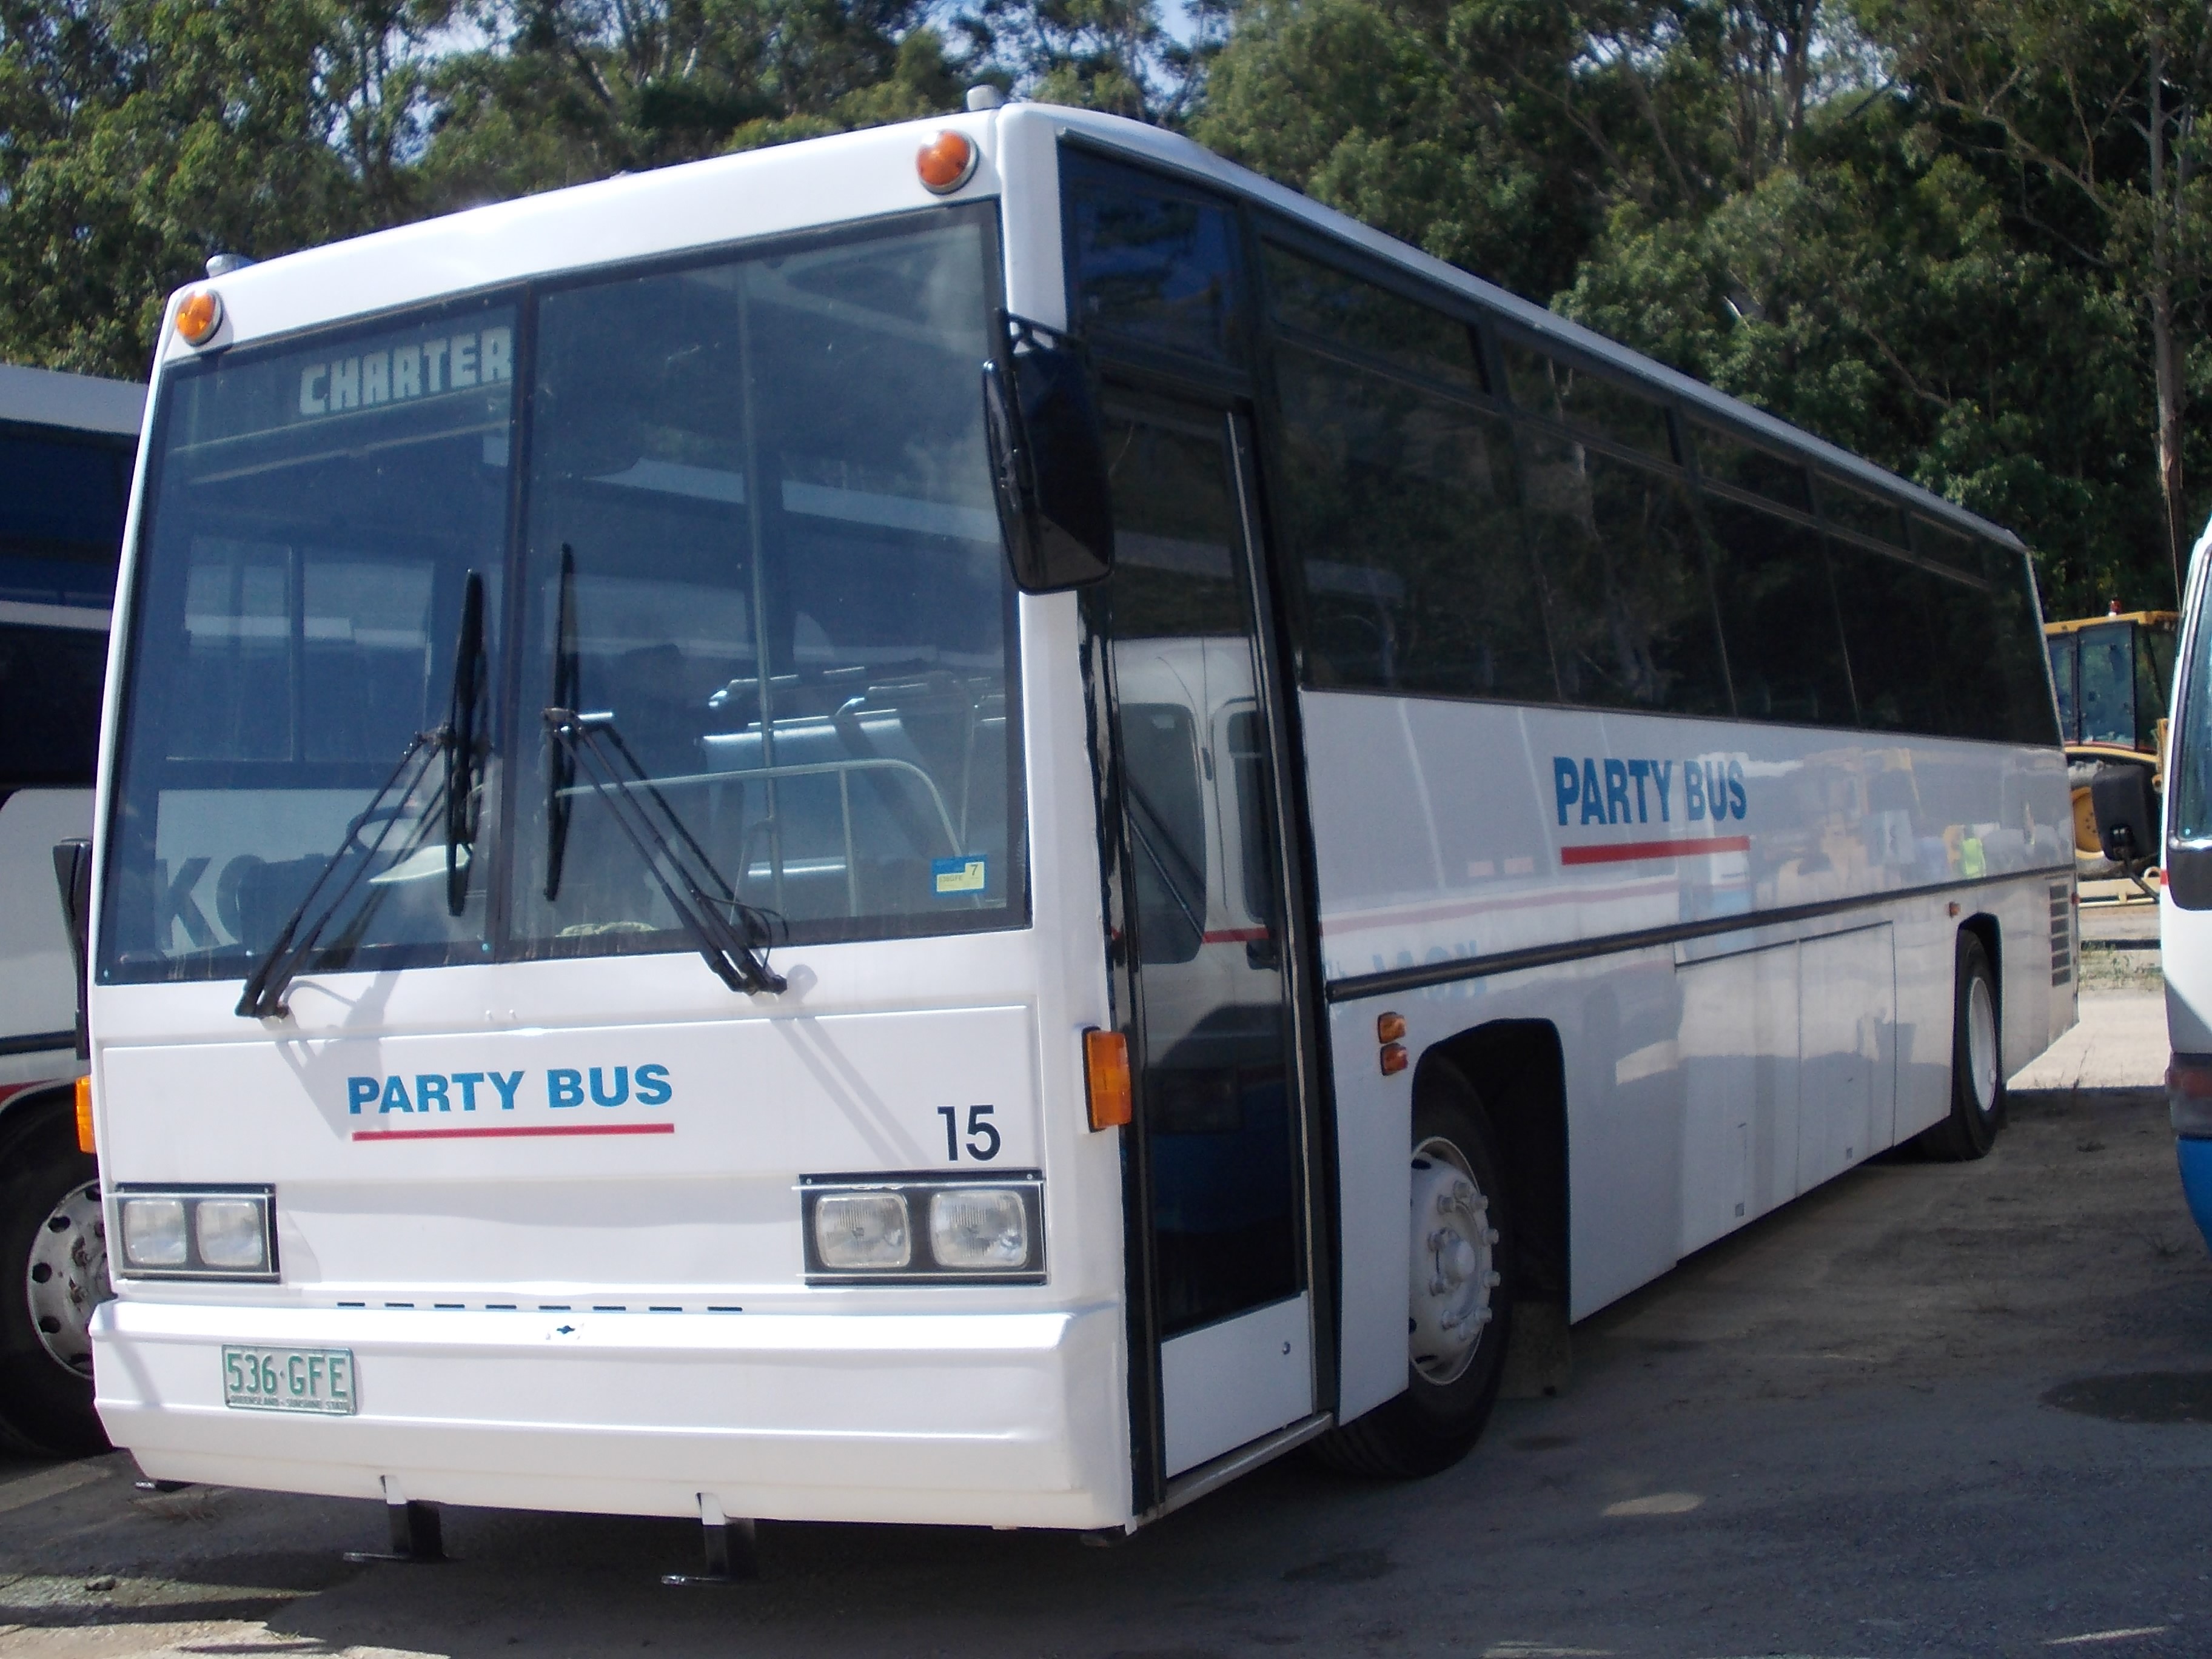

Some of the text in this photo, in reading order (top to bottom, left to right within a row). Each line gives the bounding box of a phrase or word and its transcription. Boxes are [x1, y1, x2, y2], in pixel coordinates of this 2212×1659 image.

[300, 326, 511, 415] CHARTER
[1553, 756, 1747, 826] PARTY BUS
[347, 1064, 672, 1114] PARTY BUS
[937, 1104, 1001, 1161] 15
